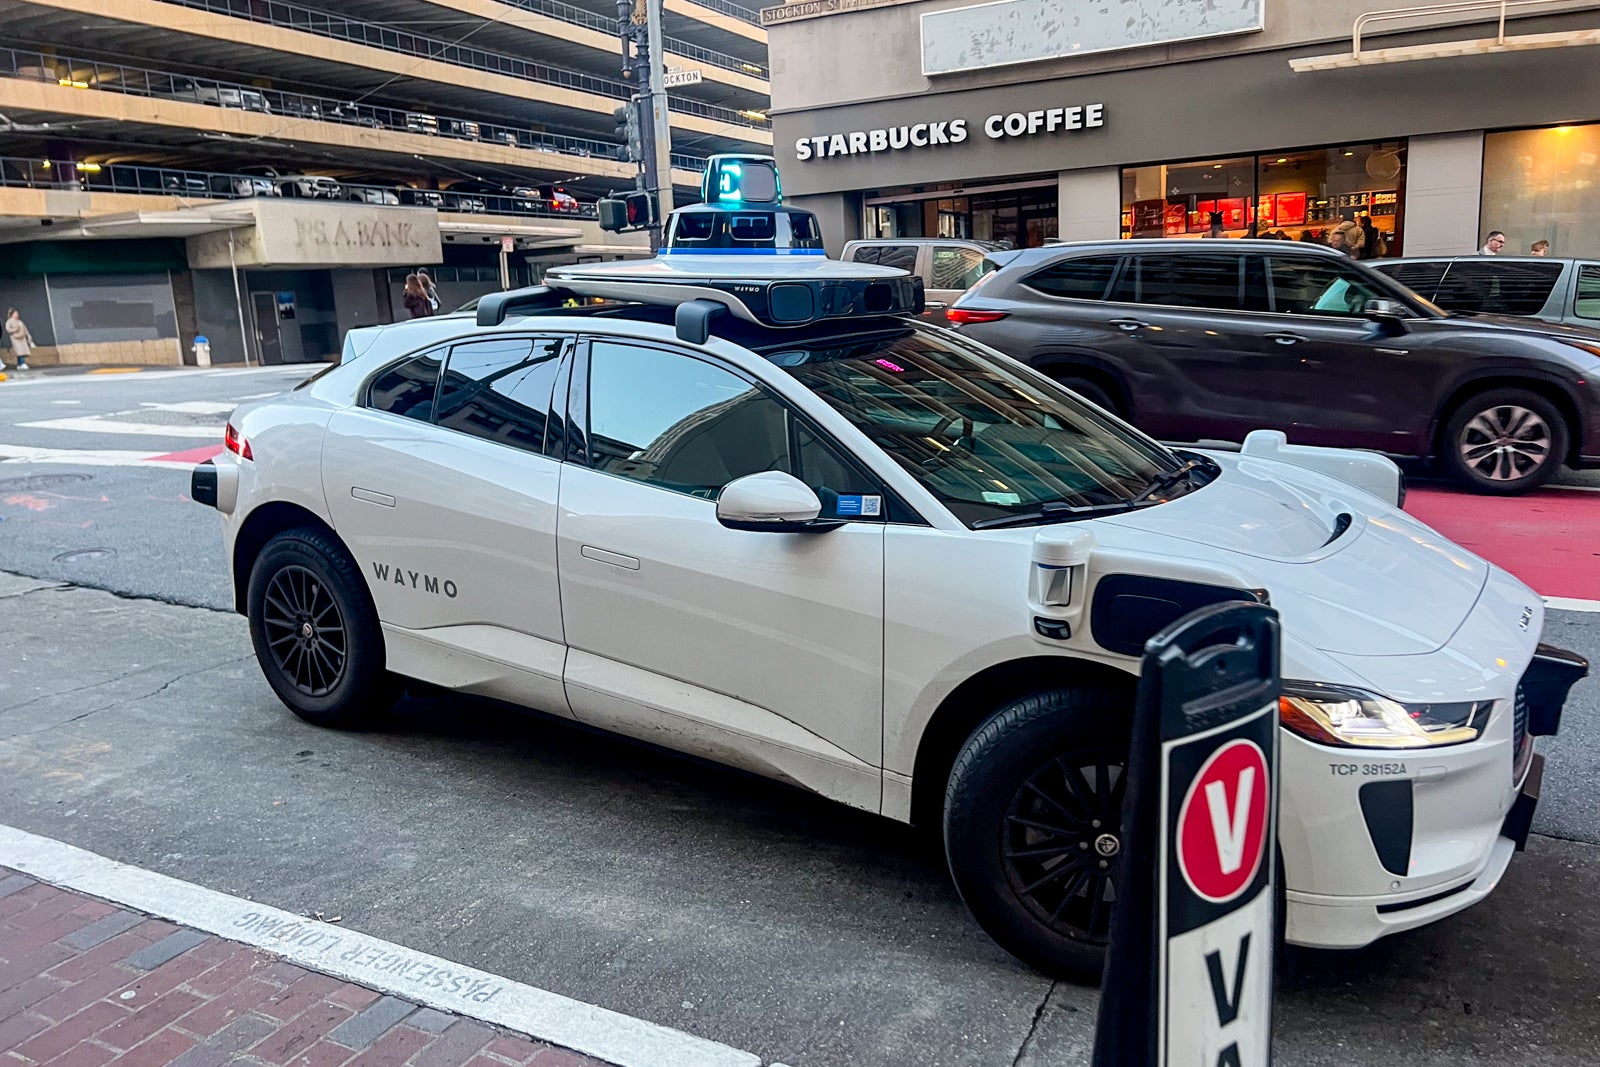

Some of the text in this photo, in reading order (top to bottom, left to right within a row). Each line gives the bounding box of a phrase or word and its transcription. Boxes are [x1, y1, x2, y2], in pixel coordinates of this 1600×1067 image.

[764, 1, 821, 22] STOCKTON
[663, 71, 698, 85] OCKTON
[795, 103, 1104, 160] STARBUCKS COFFEE
[372, 561, 458, 599] WAYMO
[1329, 762, 1407, 776] TCP 38152A
[1204, 765, 1256, 876] V
[341, 942, 503, 1003] PASSENGER
